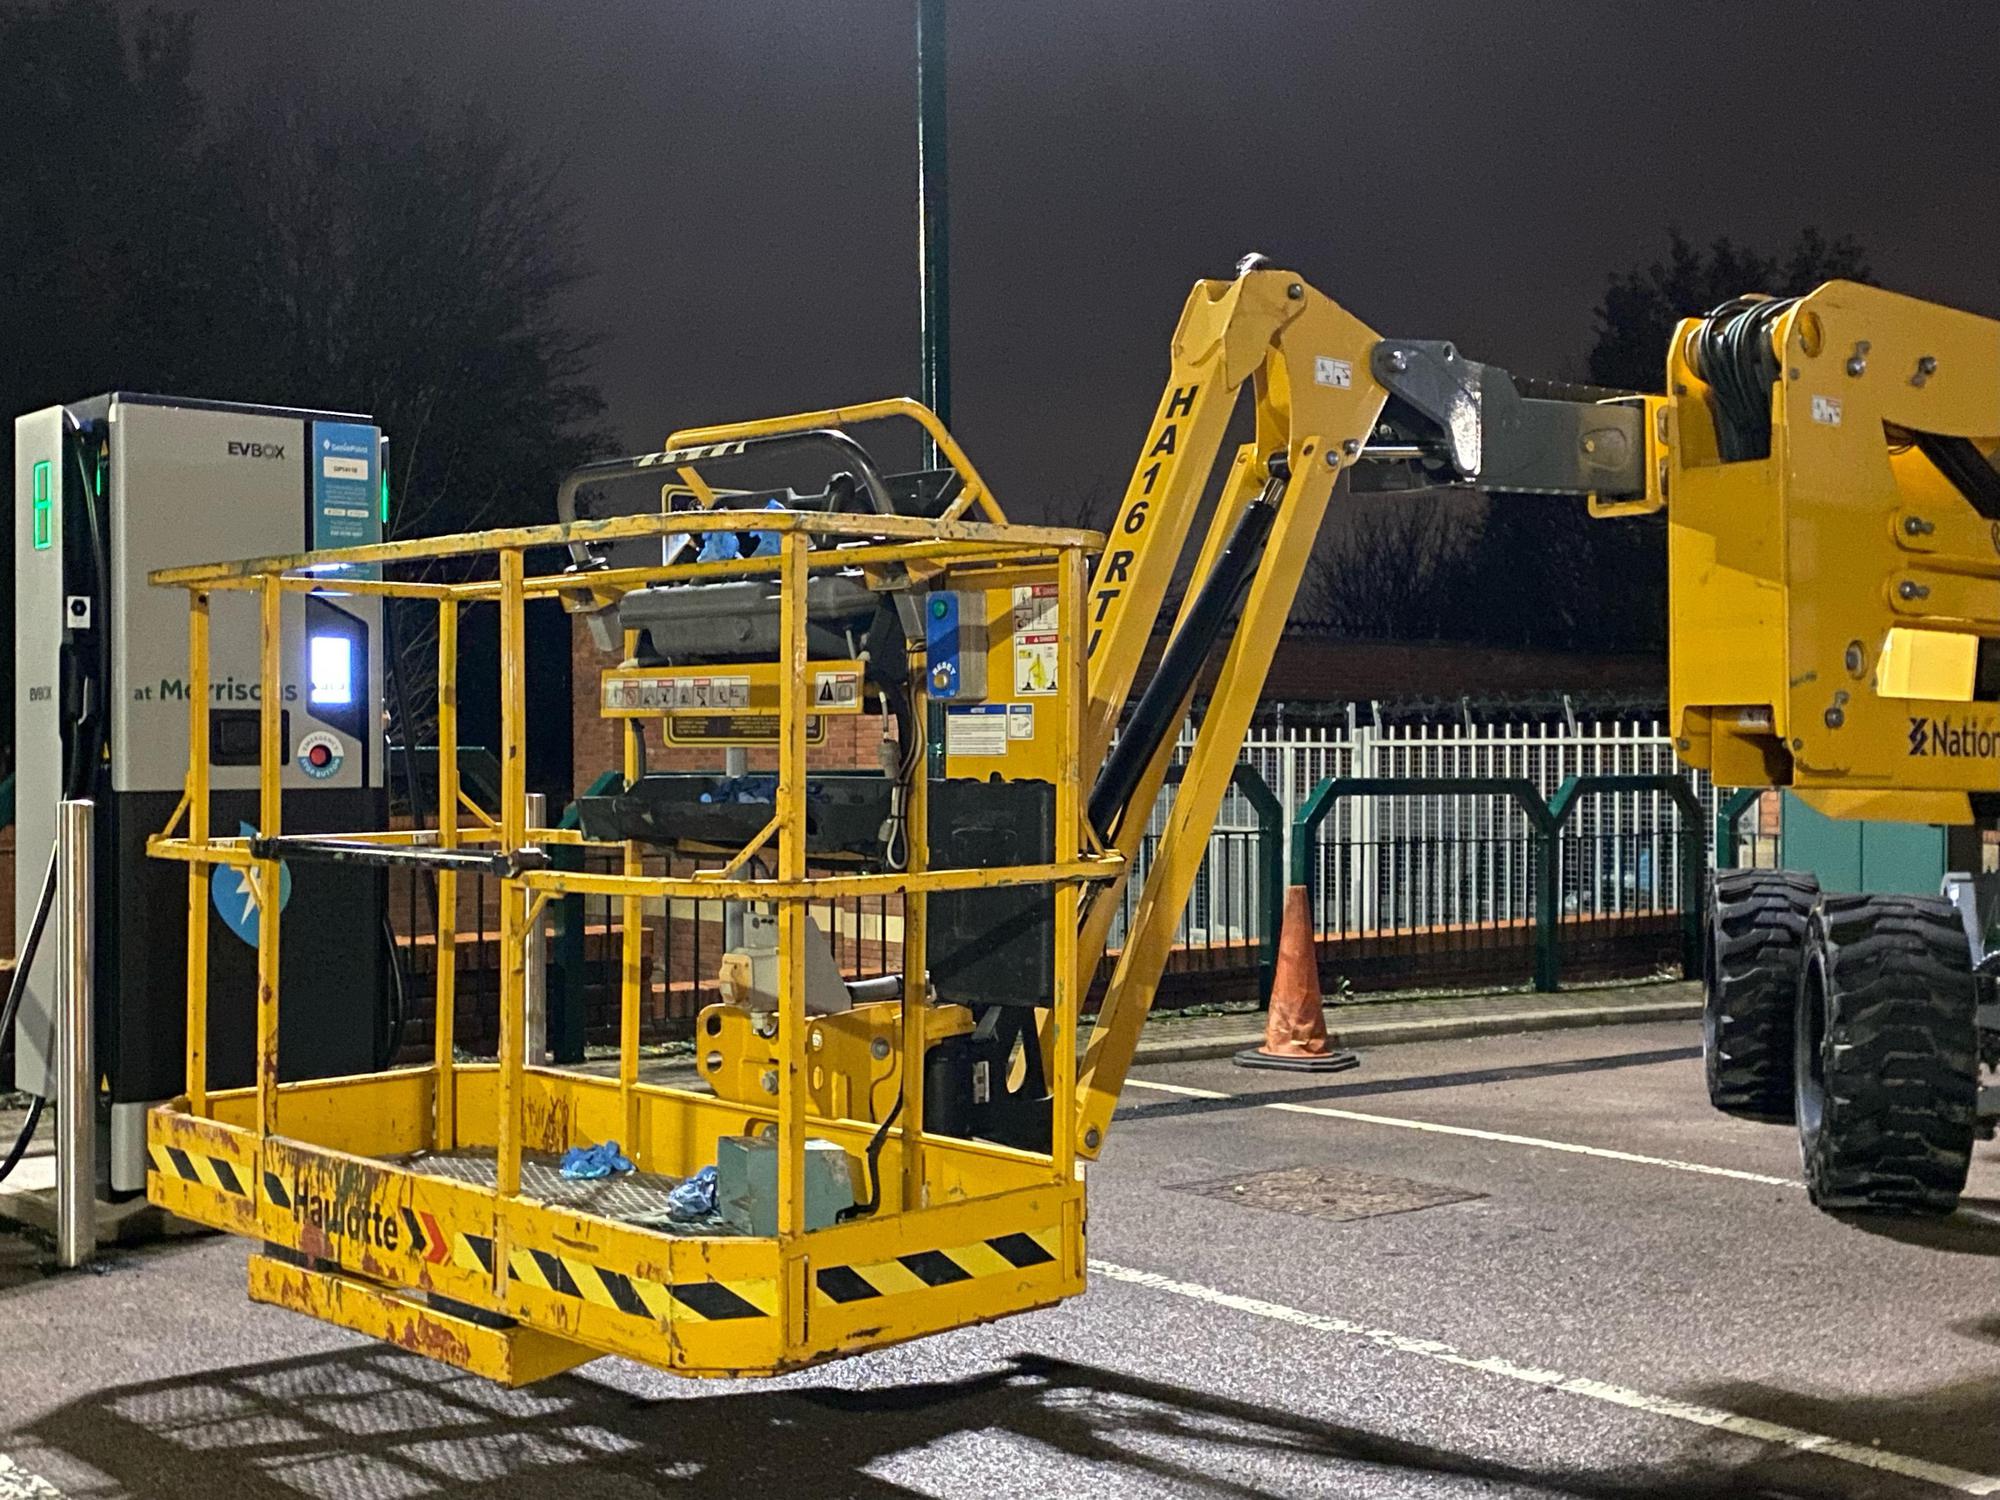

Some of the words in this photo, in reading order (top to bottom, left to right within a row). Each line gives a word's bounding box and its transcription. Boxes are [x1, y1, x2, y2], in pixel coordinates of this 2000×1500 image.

[228, 441, 285, 460] EVBOX
[932, 661, 957, 676] RESET
[133, 686, 152, 701] at
[160, 676, 298, 701] Mrisos
